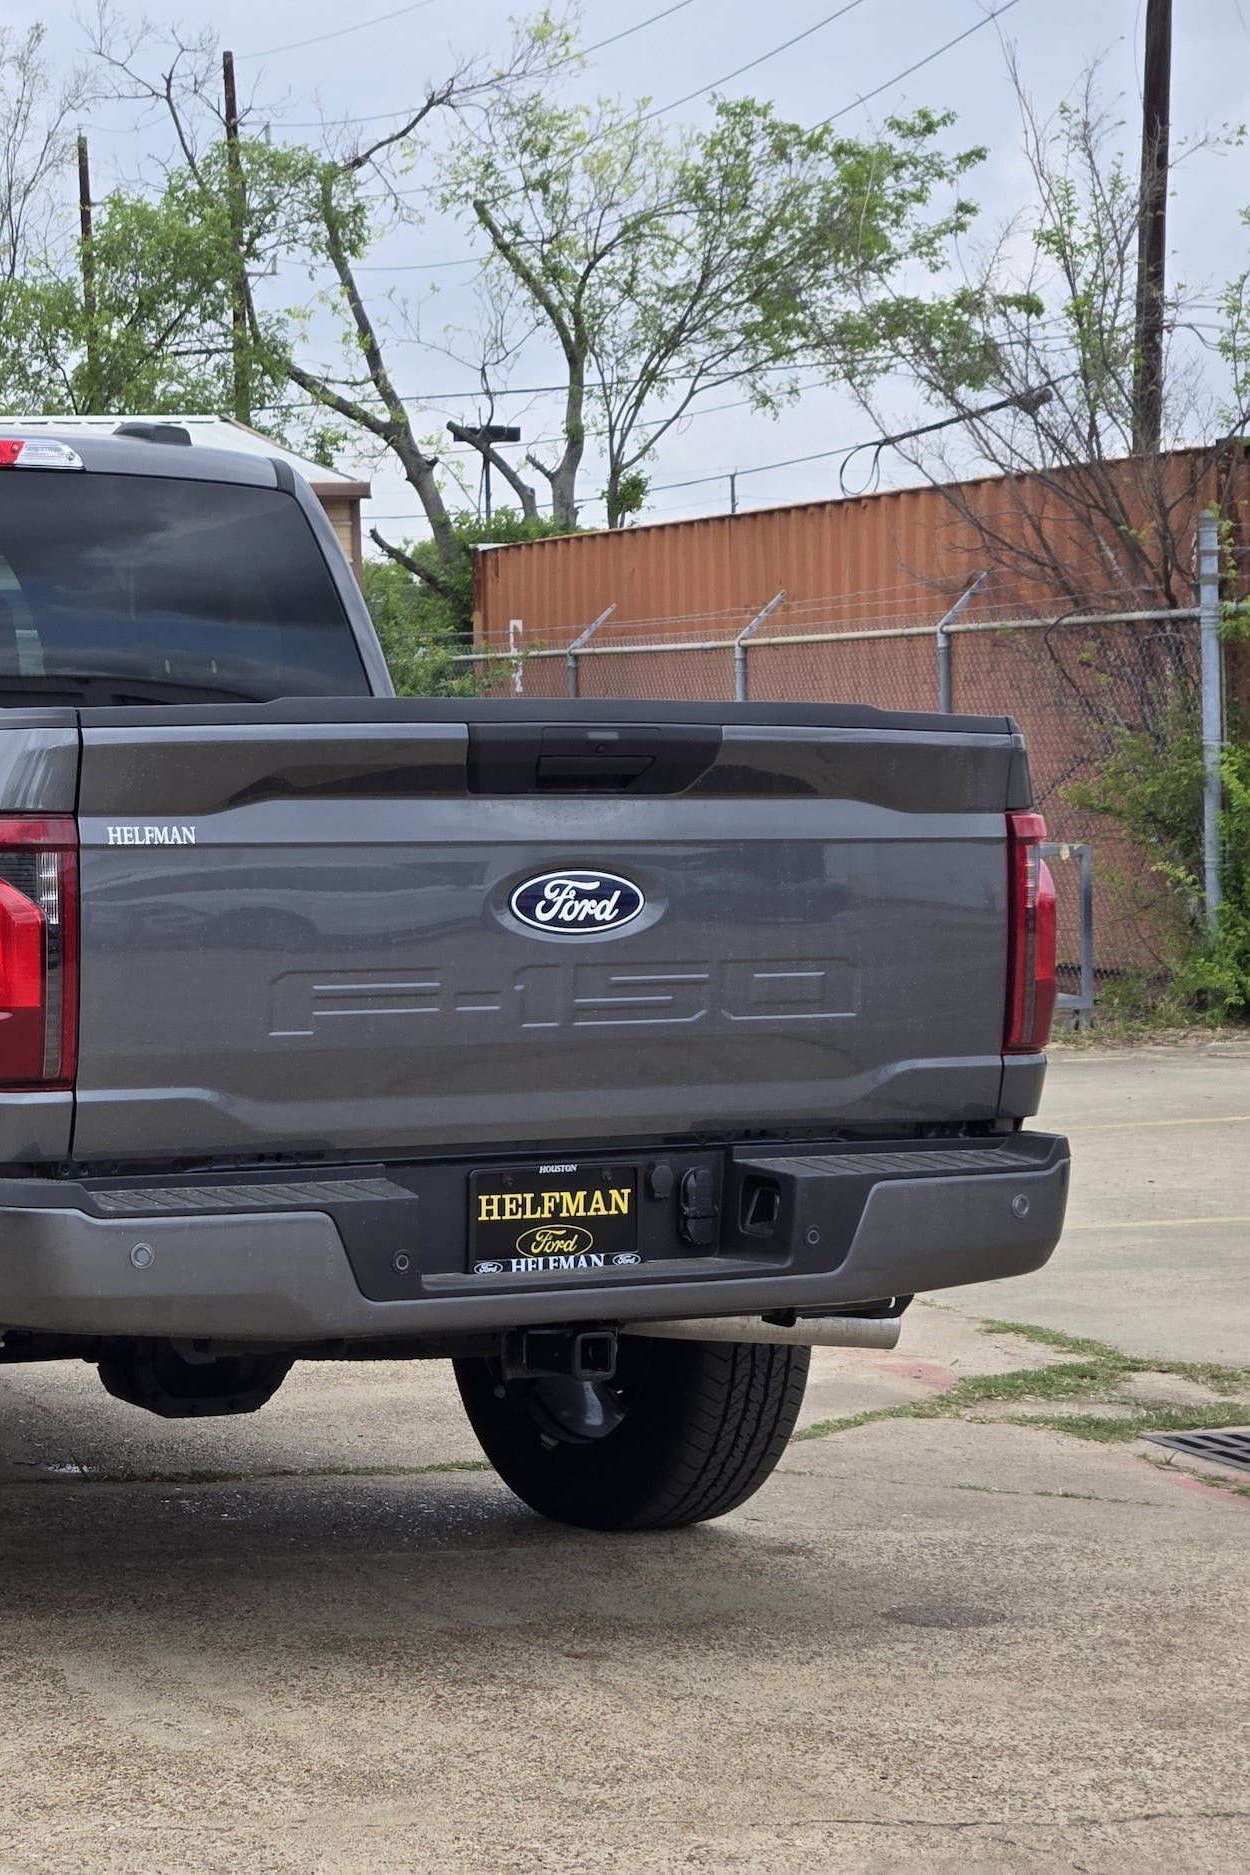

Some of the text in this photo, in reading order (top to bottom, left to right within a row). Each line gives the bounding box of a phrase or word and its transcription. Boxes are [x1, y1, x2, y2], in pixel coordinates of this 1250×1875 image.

[107, 826, 196, 845] HELFMAN
[535, 879, 621, 922] Ford
[270, 958, 857, 1036] F-150
[539, 1164, 578, 1174] HOUSTON
[478, 1189, 632, 1221] HELFMAN
[531, 1229, 579, 1254] Ford
